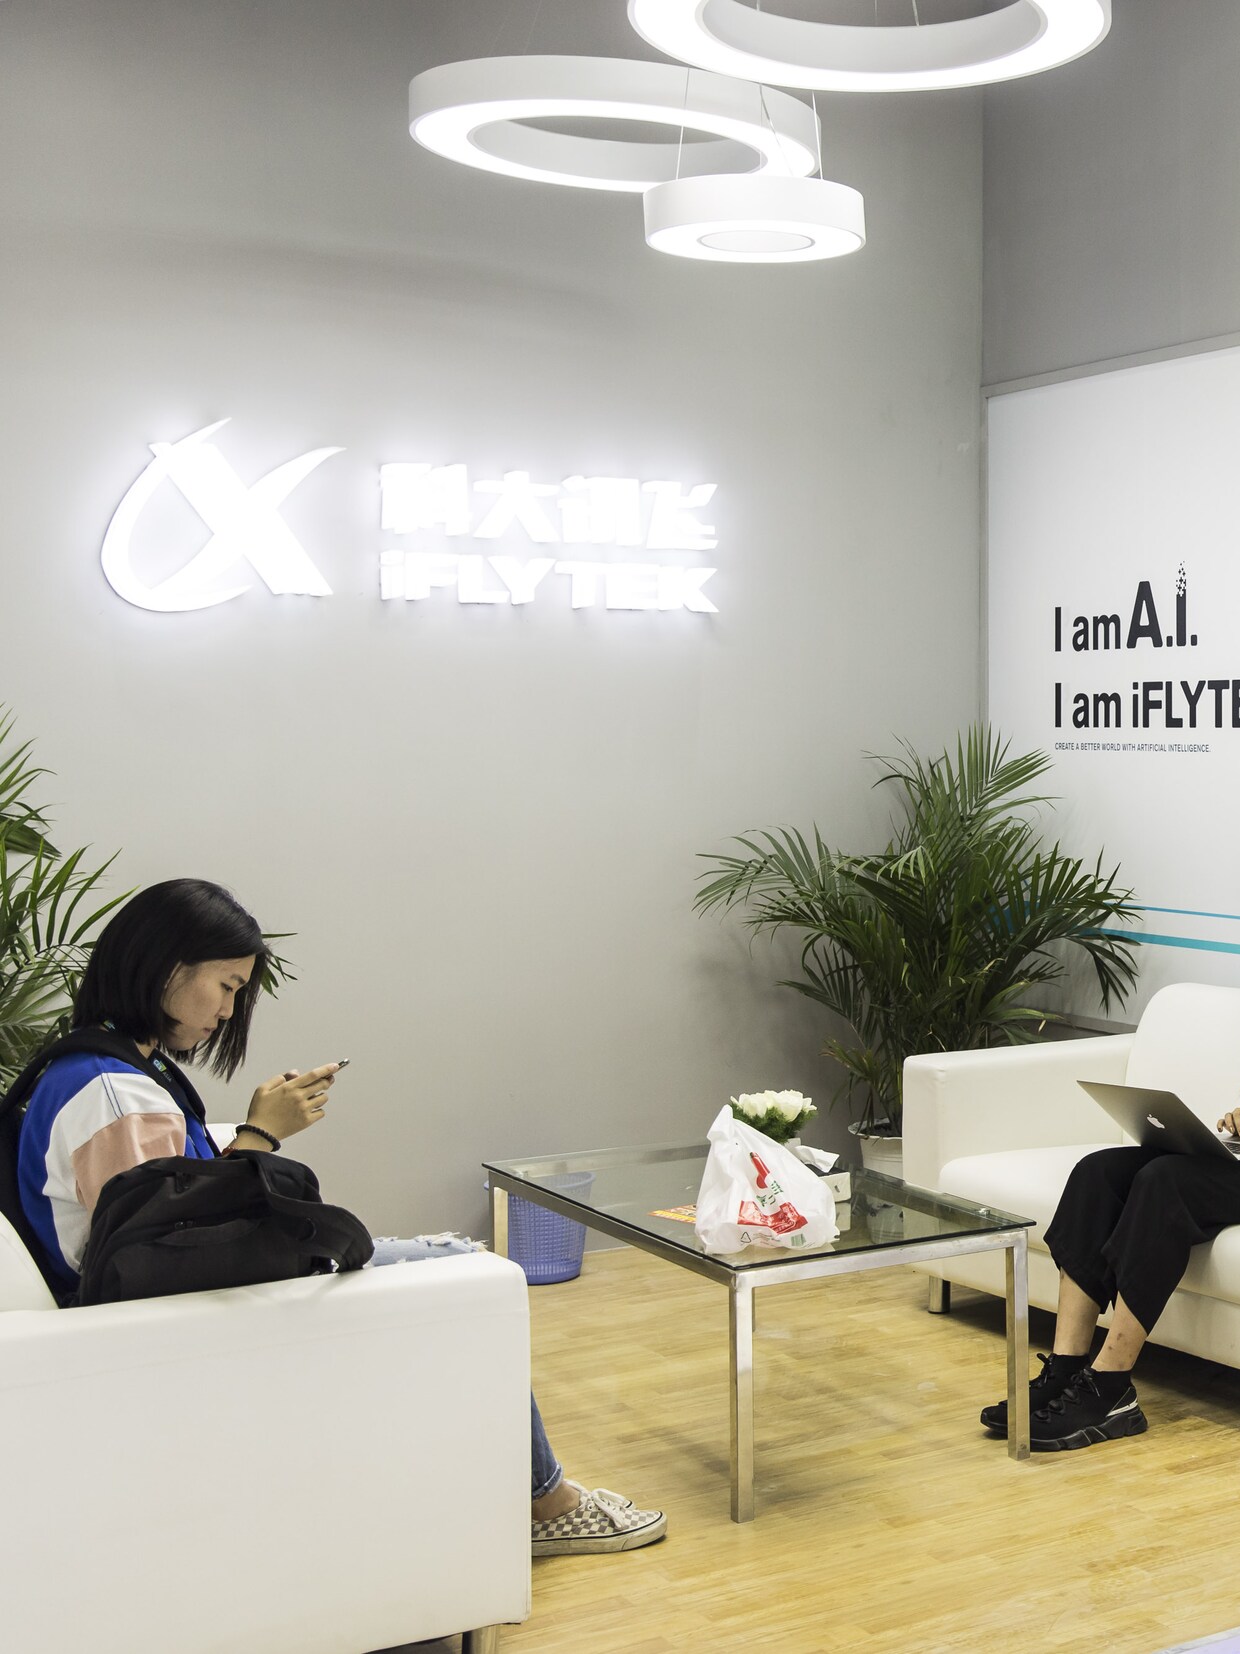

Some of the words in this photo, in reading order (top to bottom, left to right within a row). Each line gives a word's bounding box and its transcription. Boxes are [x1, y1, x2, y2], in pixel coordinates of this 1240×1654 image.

[380, 549, 720, 613] iFLYTEK
[1055, 606, 1062, 652] I
[1072, 613, 1121, 652] am
[1126, 561, 1198, 649] A.I.
[1055, 682, 1062, 728] I
[1072, 692, 1122, 729] am
[1055, 742, 1075, 751] CREATE
[1081, 742, 1100, 751] BETTER
[1101, 743, 1121, 752] WORLD
[1122, 743, 1136, 752] WITH
[1137, 743, 1167, 752] ARTIFICIAL
